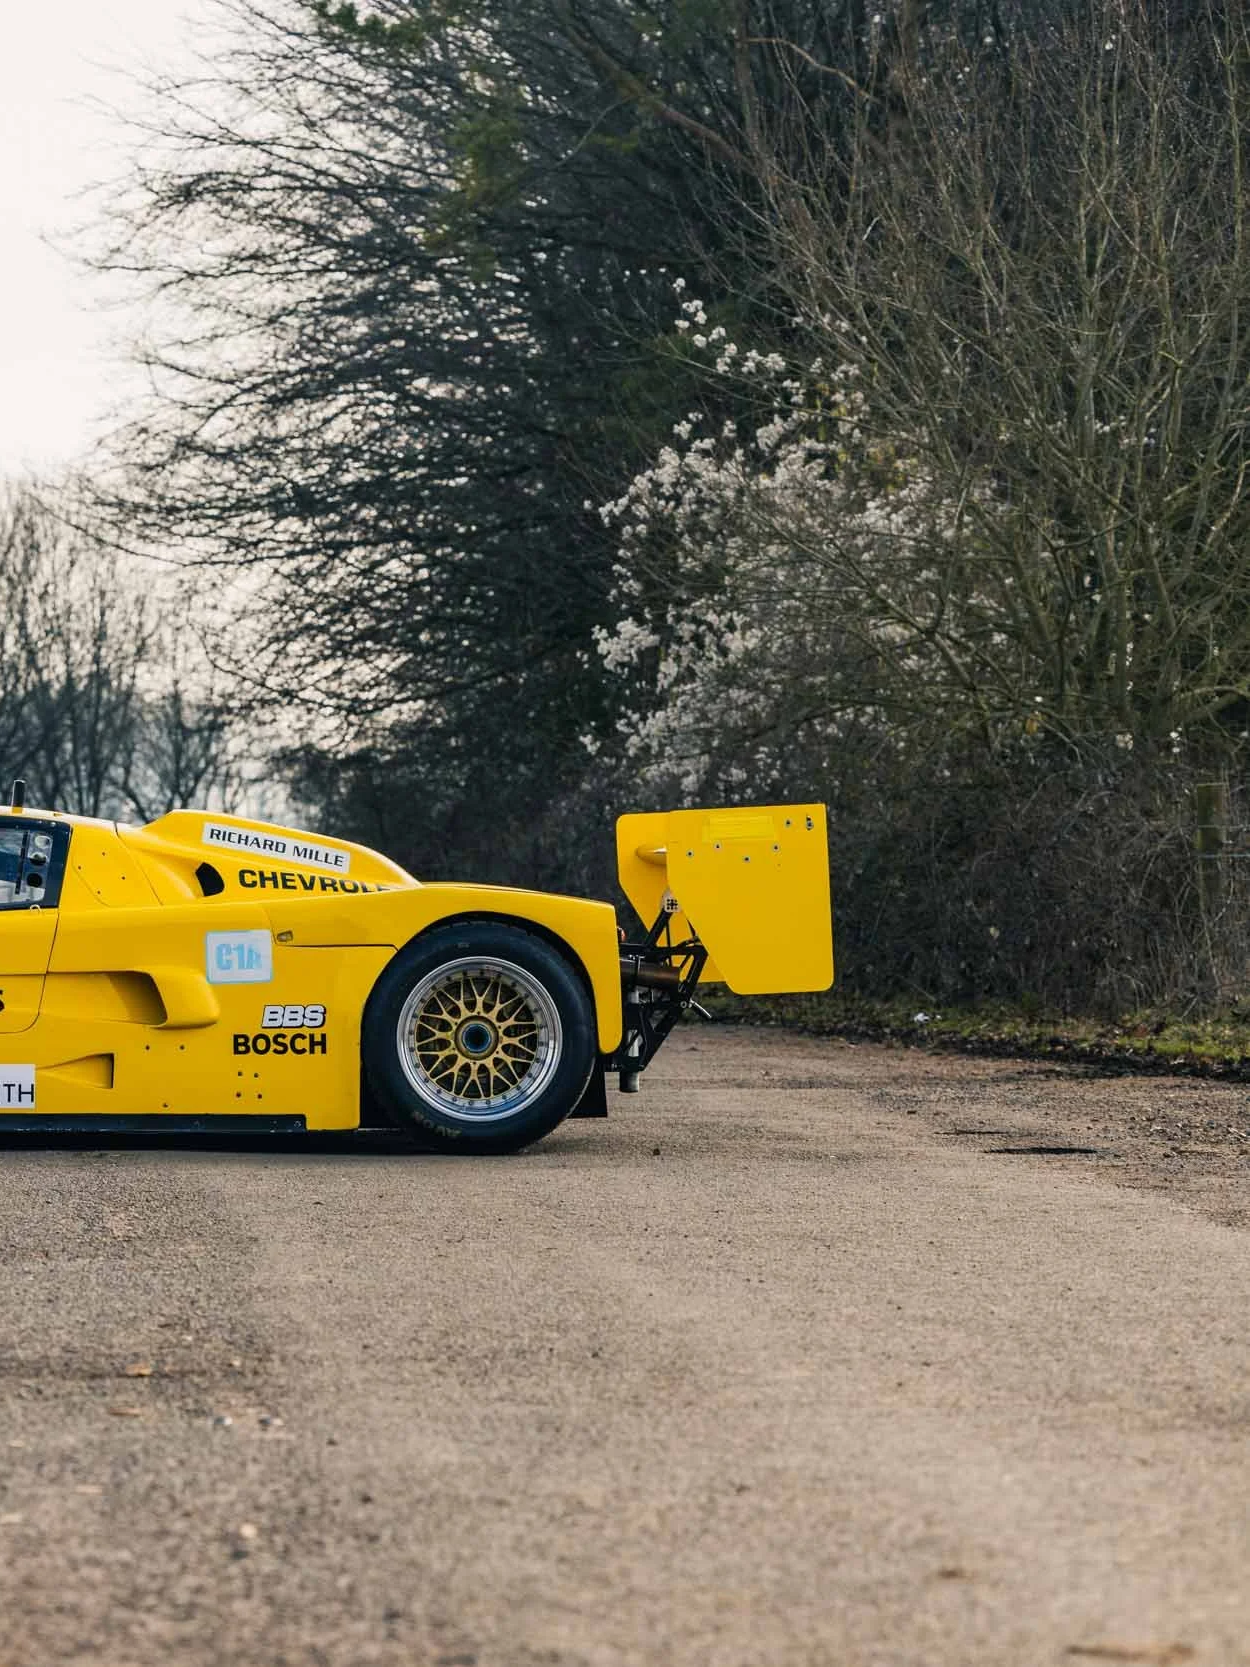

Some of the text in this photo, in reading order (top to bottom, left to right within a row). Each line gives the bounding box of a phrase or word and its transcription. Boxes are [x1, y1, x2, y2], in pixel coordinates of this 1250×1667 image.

[210, 828, 345, 867] RICHARD MILLE
[261, 1004, 327, 1029] BBS
[233, 1033, 327, 1055] BOSCH
